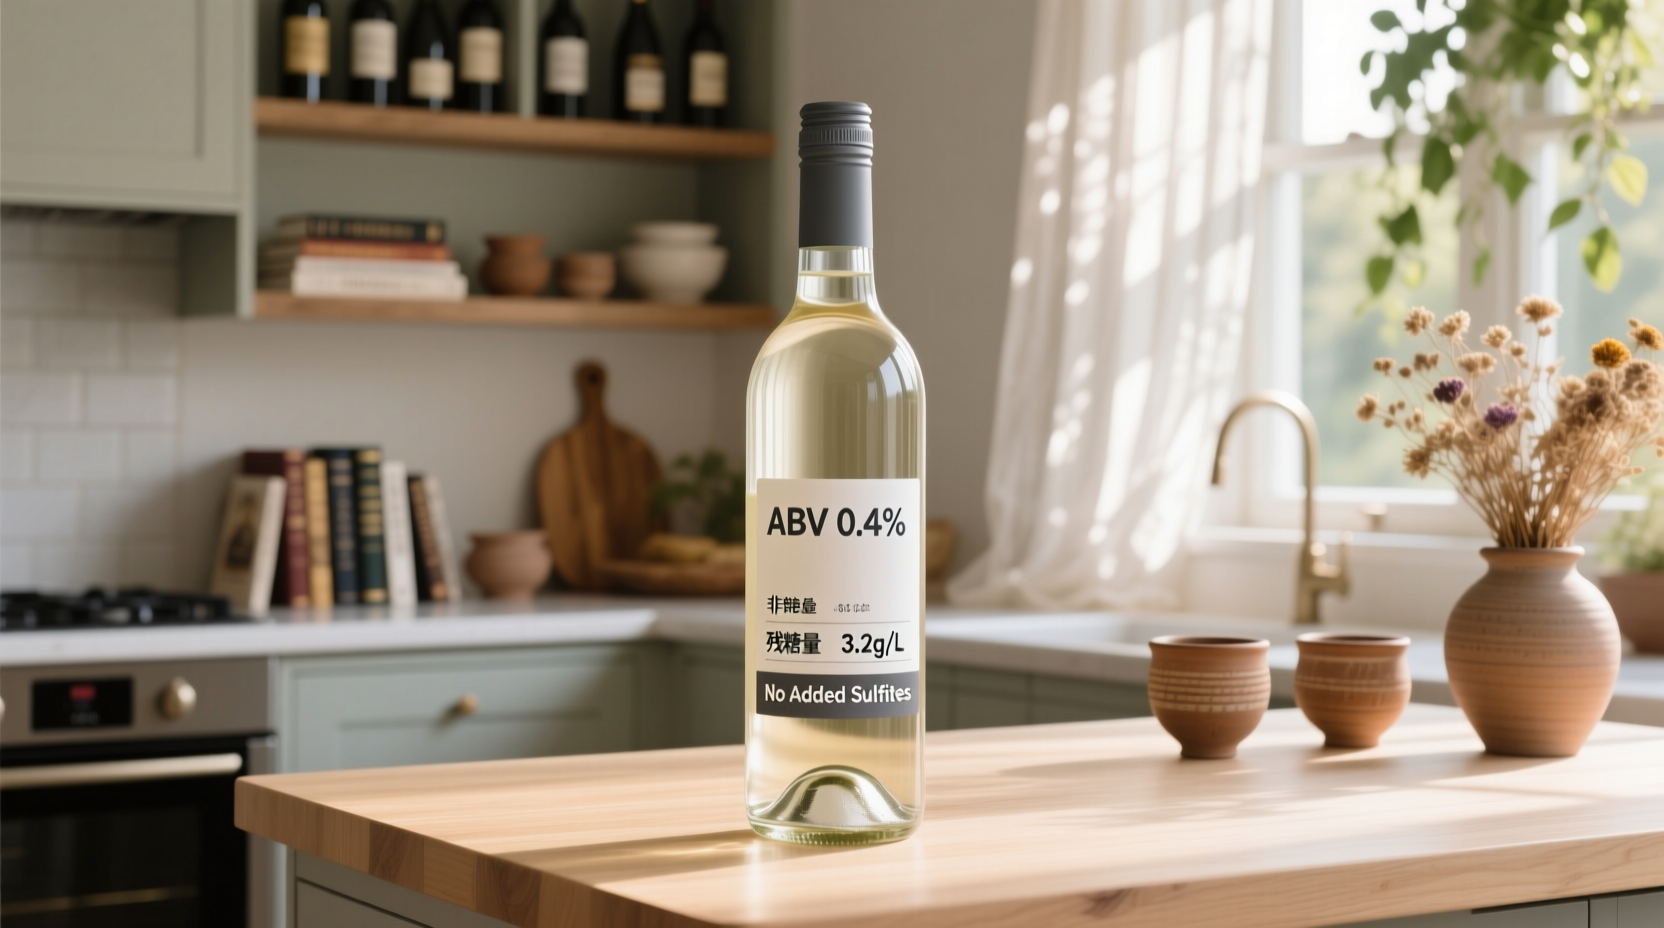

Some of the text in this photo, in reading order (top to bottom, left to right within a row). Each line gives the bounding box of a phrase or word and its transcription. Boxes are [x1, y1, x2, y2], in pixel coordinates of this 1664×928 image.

[767, 506, 906, 537] ABV 0.4%
[841, 630, 905, 659] 3.2g/L
[765, 683, 912, 704] No Added Sulfites
